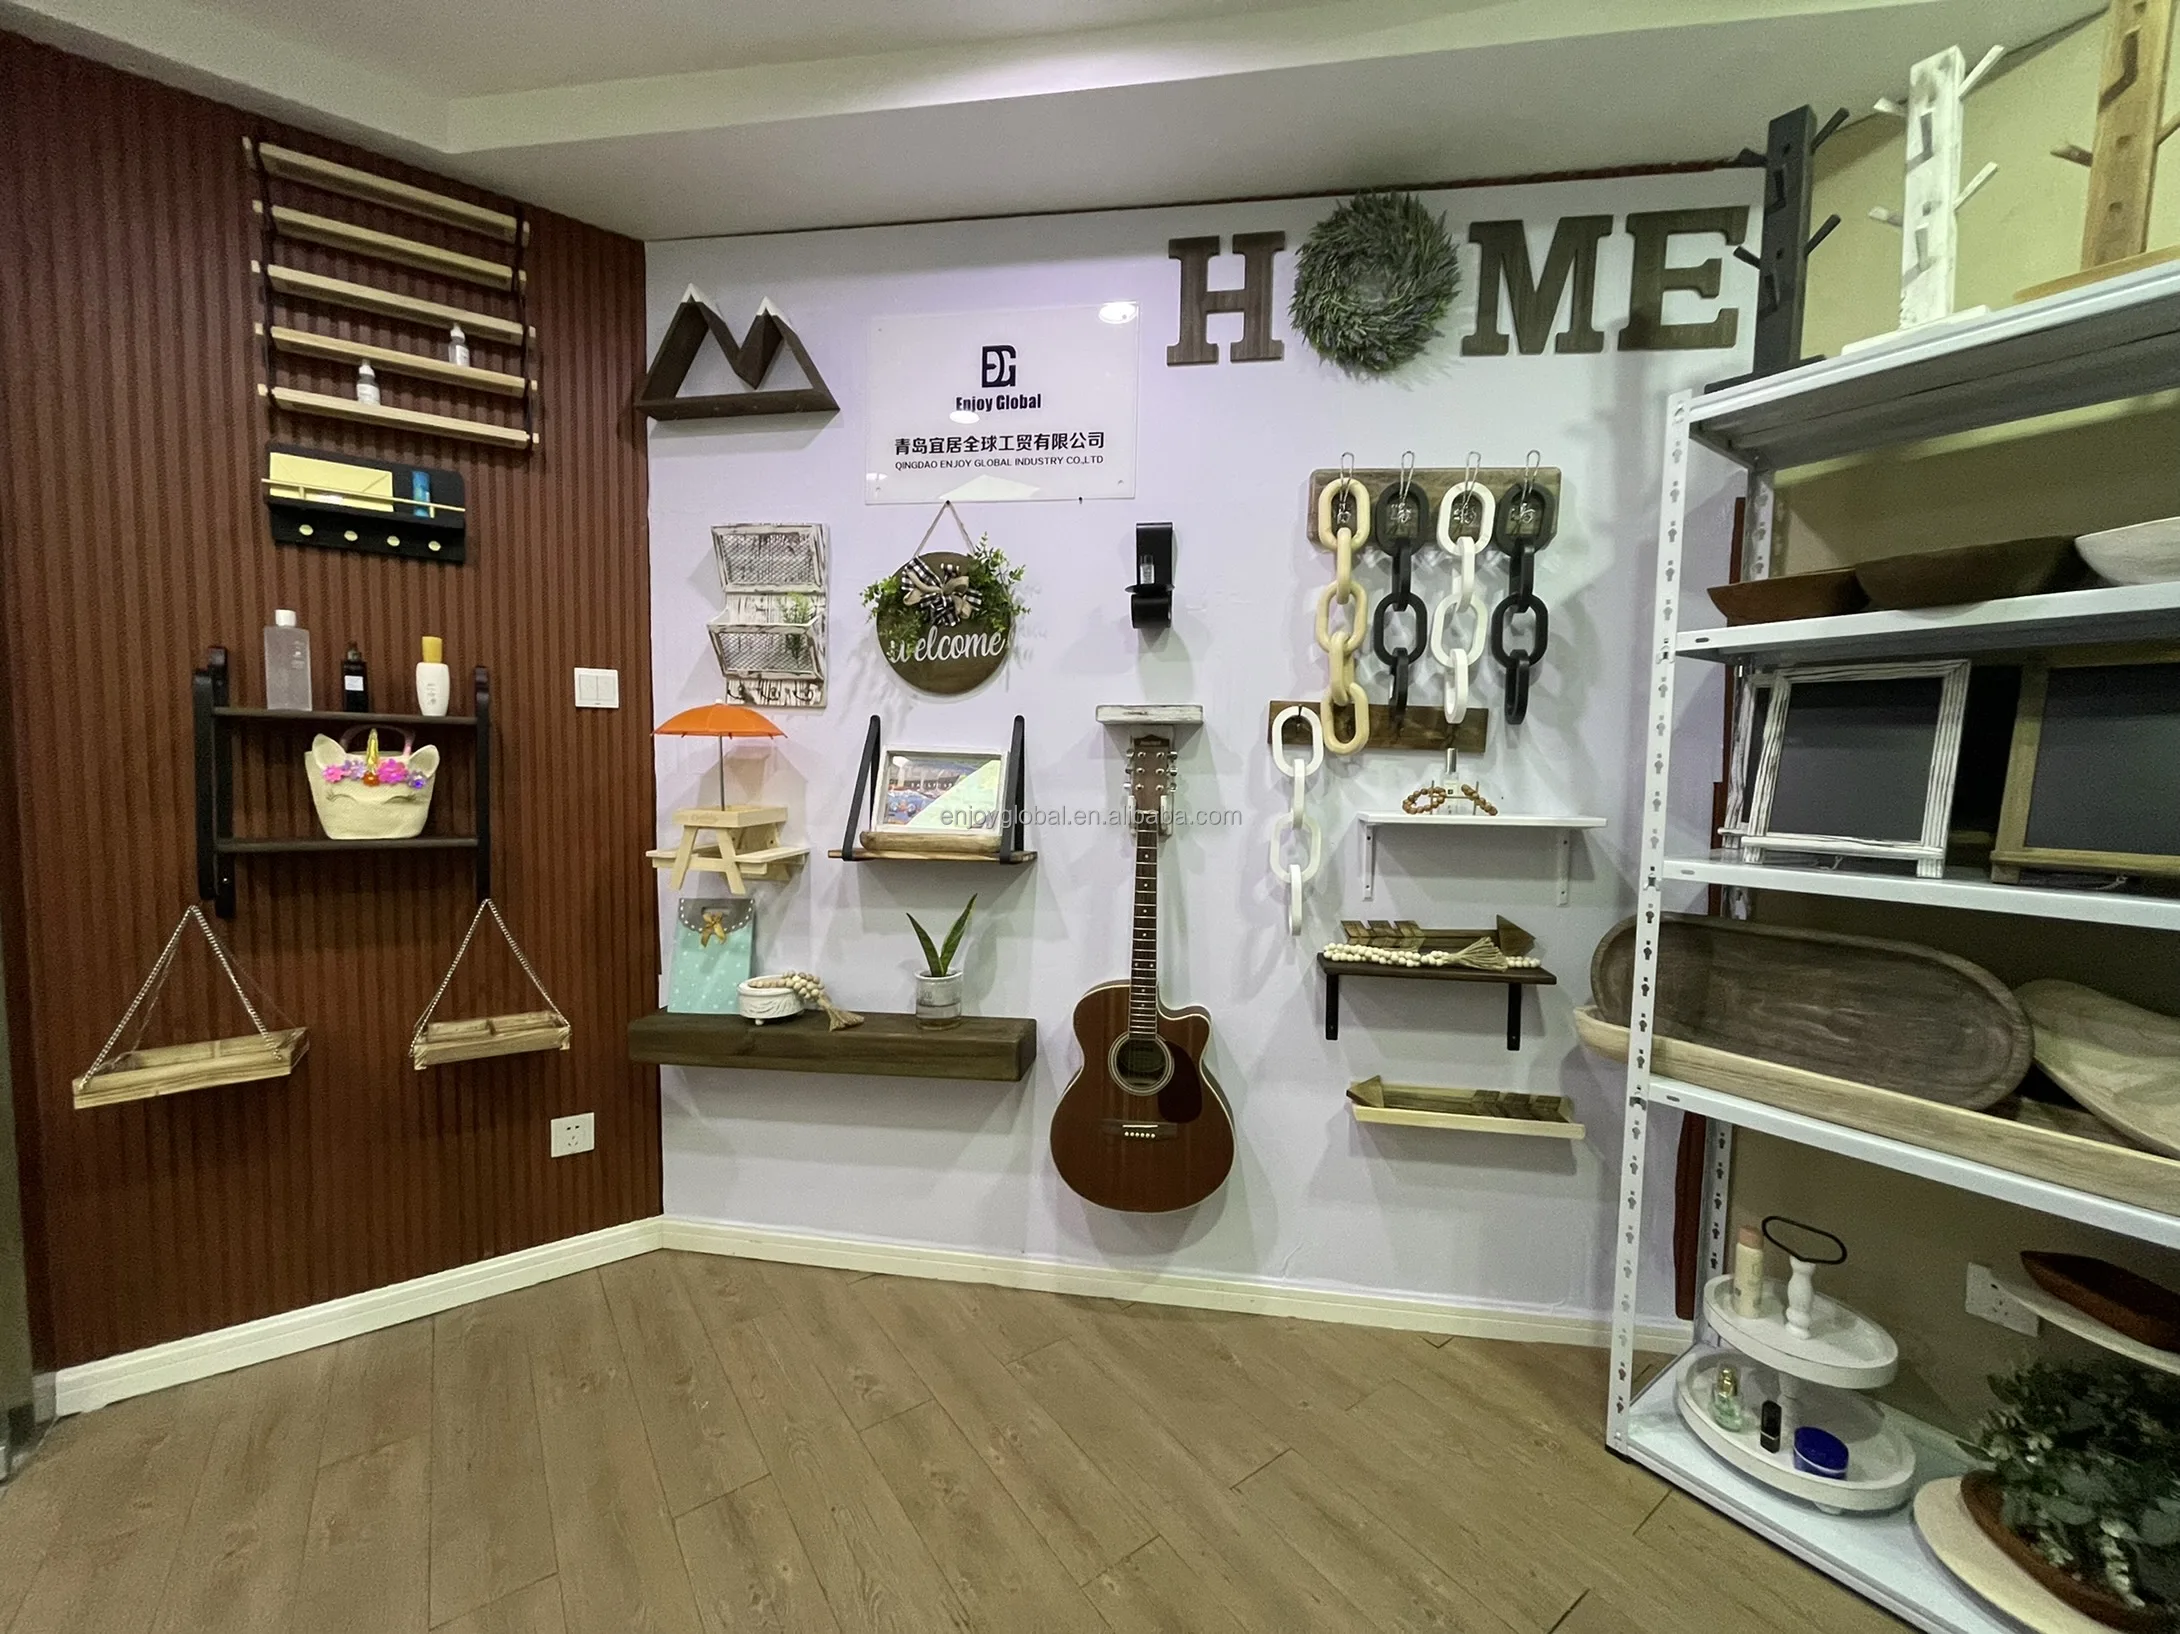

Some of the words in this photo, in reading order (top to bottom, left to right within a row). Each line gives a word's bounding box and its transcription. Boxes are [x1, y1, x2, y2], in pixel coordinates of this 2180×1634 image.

[956, 396, 993, 412] Enjoy
[996, 394, 1042, 410] Global
[894, 432, 1105, 455] 青岛宜居全球工贸有限公司
[895, 460, 938, 471] QINGDAO
[940, 459, 972, 468] ENJOY
[974, 458, 1012, 467] GLOBAL
[1015, 456, 1063, 466] INDUSTRY
